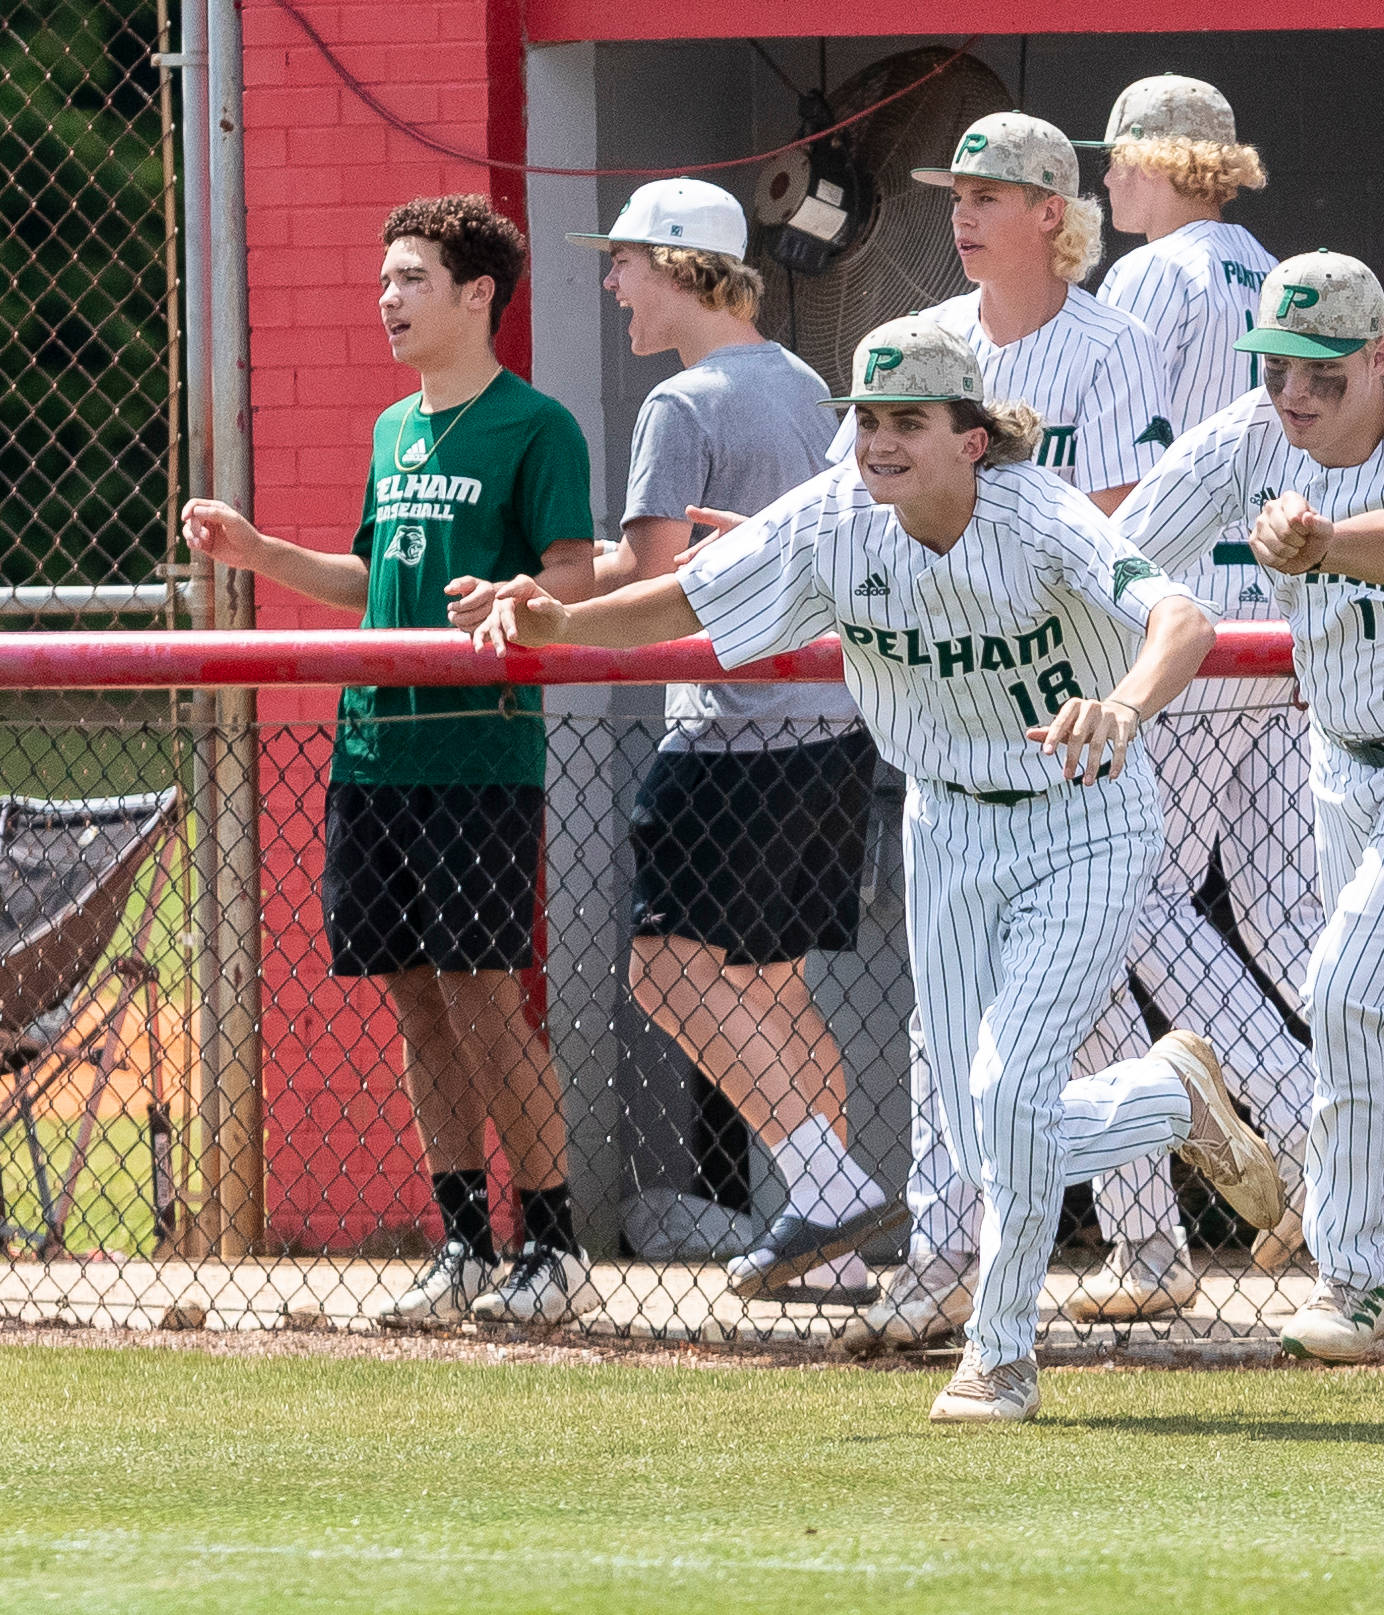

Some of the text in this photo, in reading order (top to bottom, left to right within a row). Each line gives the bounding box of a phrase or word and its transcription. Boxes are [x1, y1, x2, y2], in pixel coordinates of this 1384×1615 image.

[955, 134, 988, 163] P
[1276, 284, 1319, 319] P
[864, 347, 903, 384] P
[376, 473, 482, 504] ELHAM
[839, 615, 1063, 678] PELHAM
[1008, 660, 1084, 727] 18
